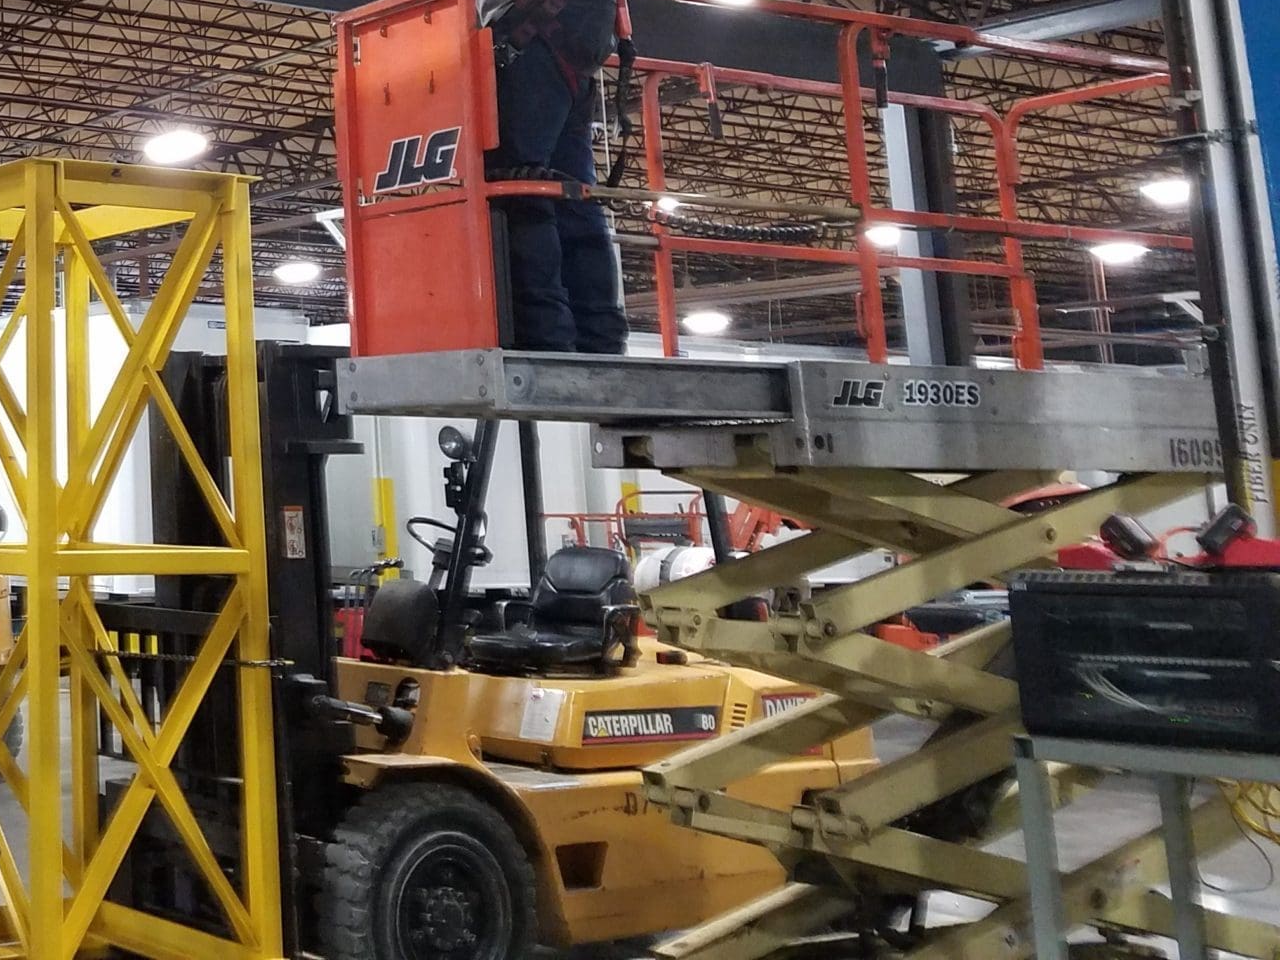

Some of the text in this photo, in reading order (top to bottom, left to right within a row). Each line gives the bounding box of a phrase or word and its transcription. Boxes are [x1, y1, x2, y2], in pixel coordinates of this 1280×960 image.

[373, 126, 461, 193] JLG
[832, 379, 980, 408] JLG 1930ES
[588, 713, 674, 737] CATERPILLAR
